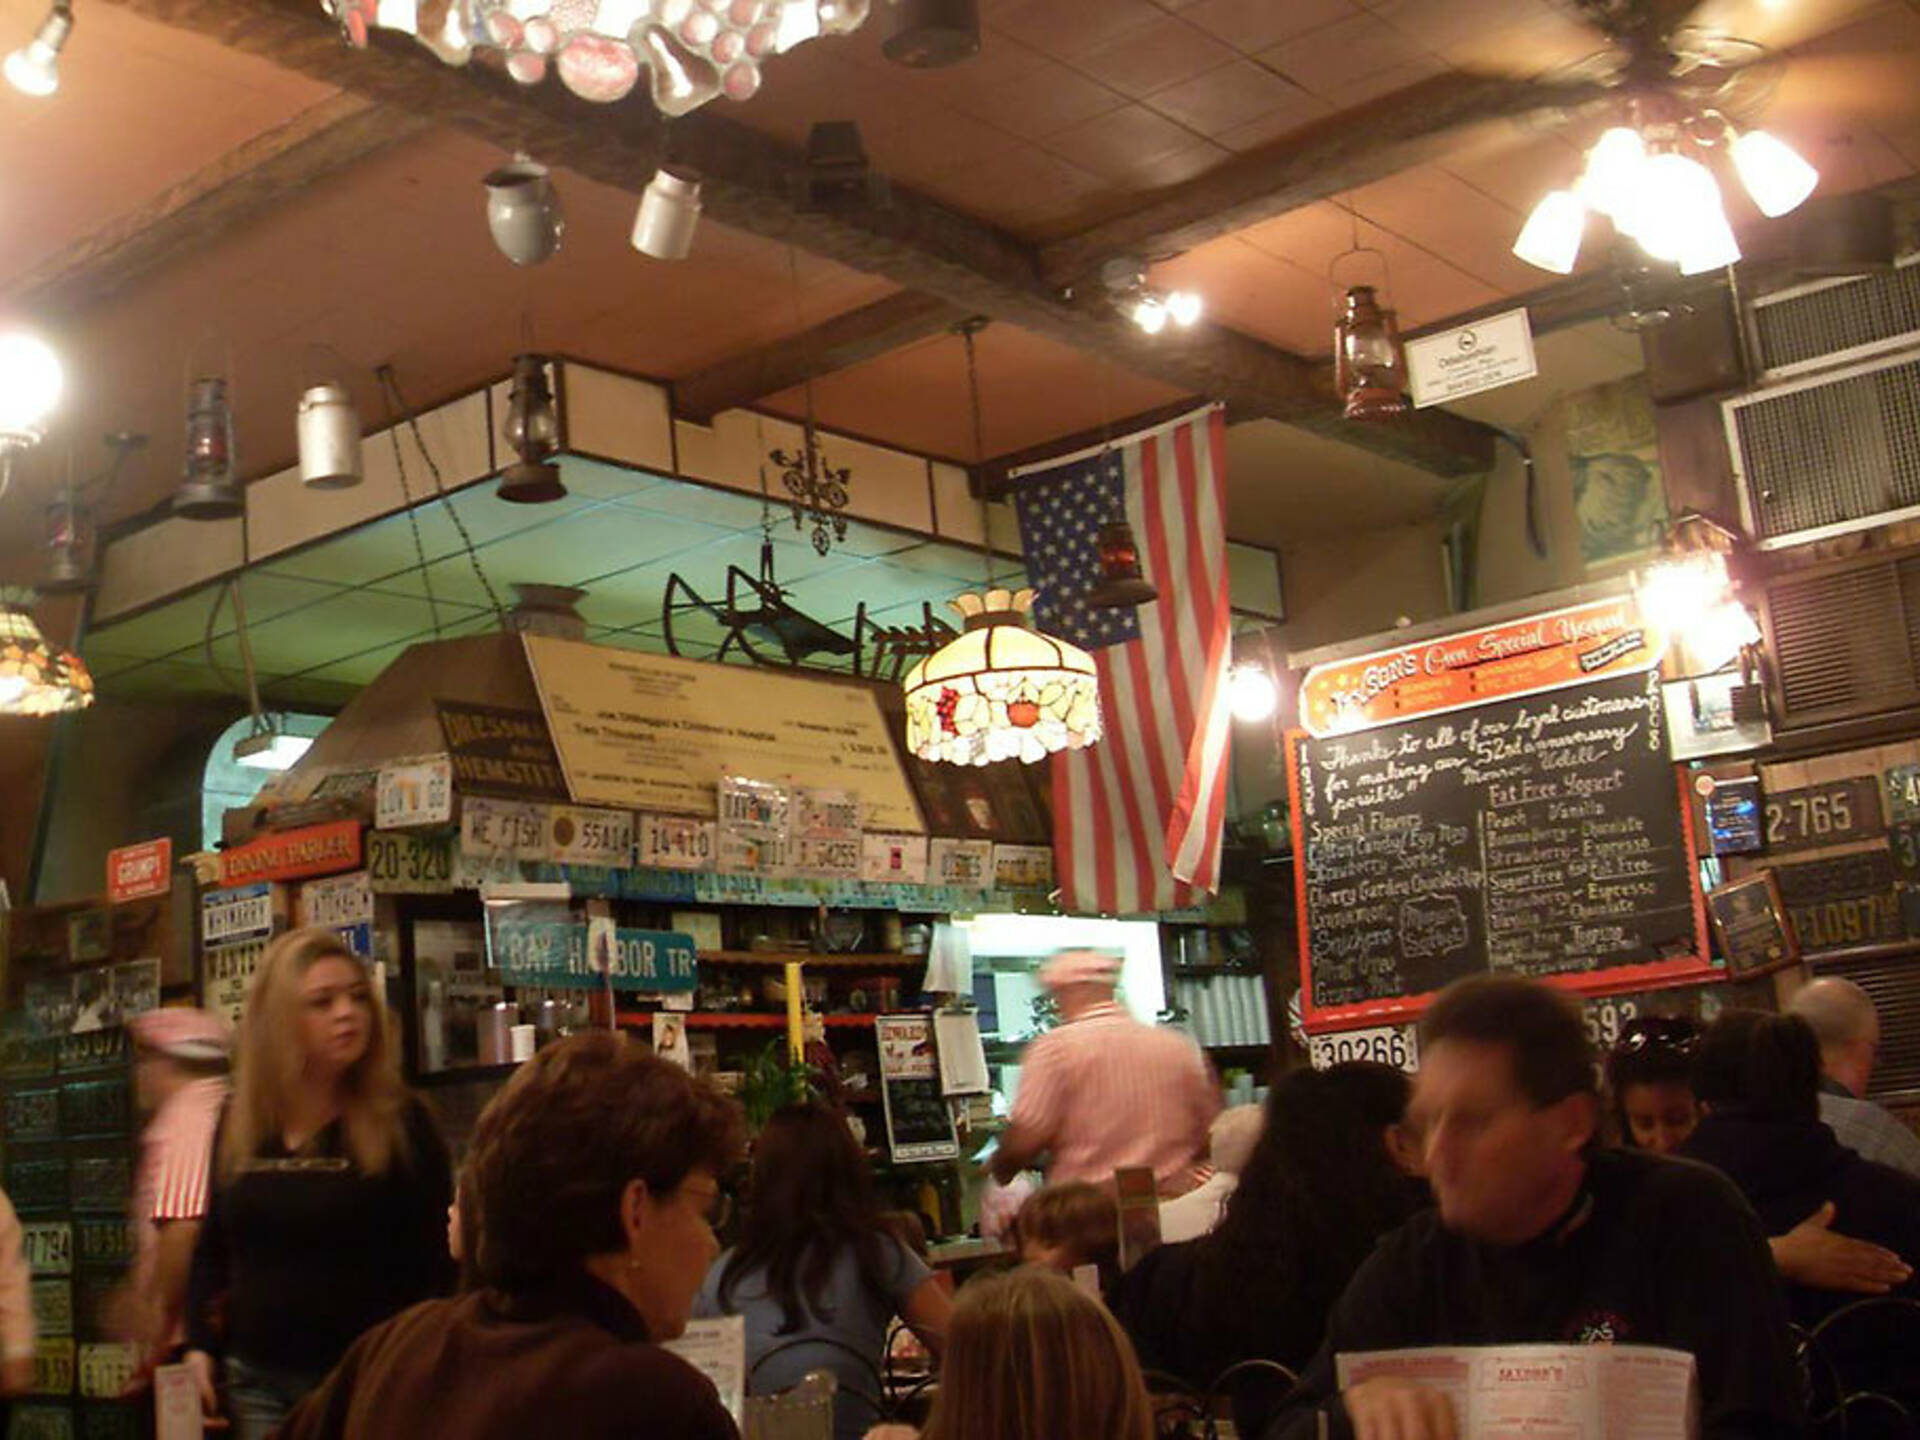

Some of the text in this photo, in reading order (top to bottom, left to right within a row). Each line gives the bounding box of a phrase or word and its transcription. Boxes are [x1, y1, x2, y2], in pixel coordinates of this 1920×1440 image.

[1479, 622, 1548, 659] Special
[1397, 734, 1422, 756] to
[1426, 726, 1457, 750] all
[1460, 718, 1480, 751] of
[1489, 784, 1516, 802] Fat
[1522, 780, 1558, 799] Free
[509, 932, 693, 978] BAY HABOR TR
